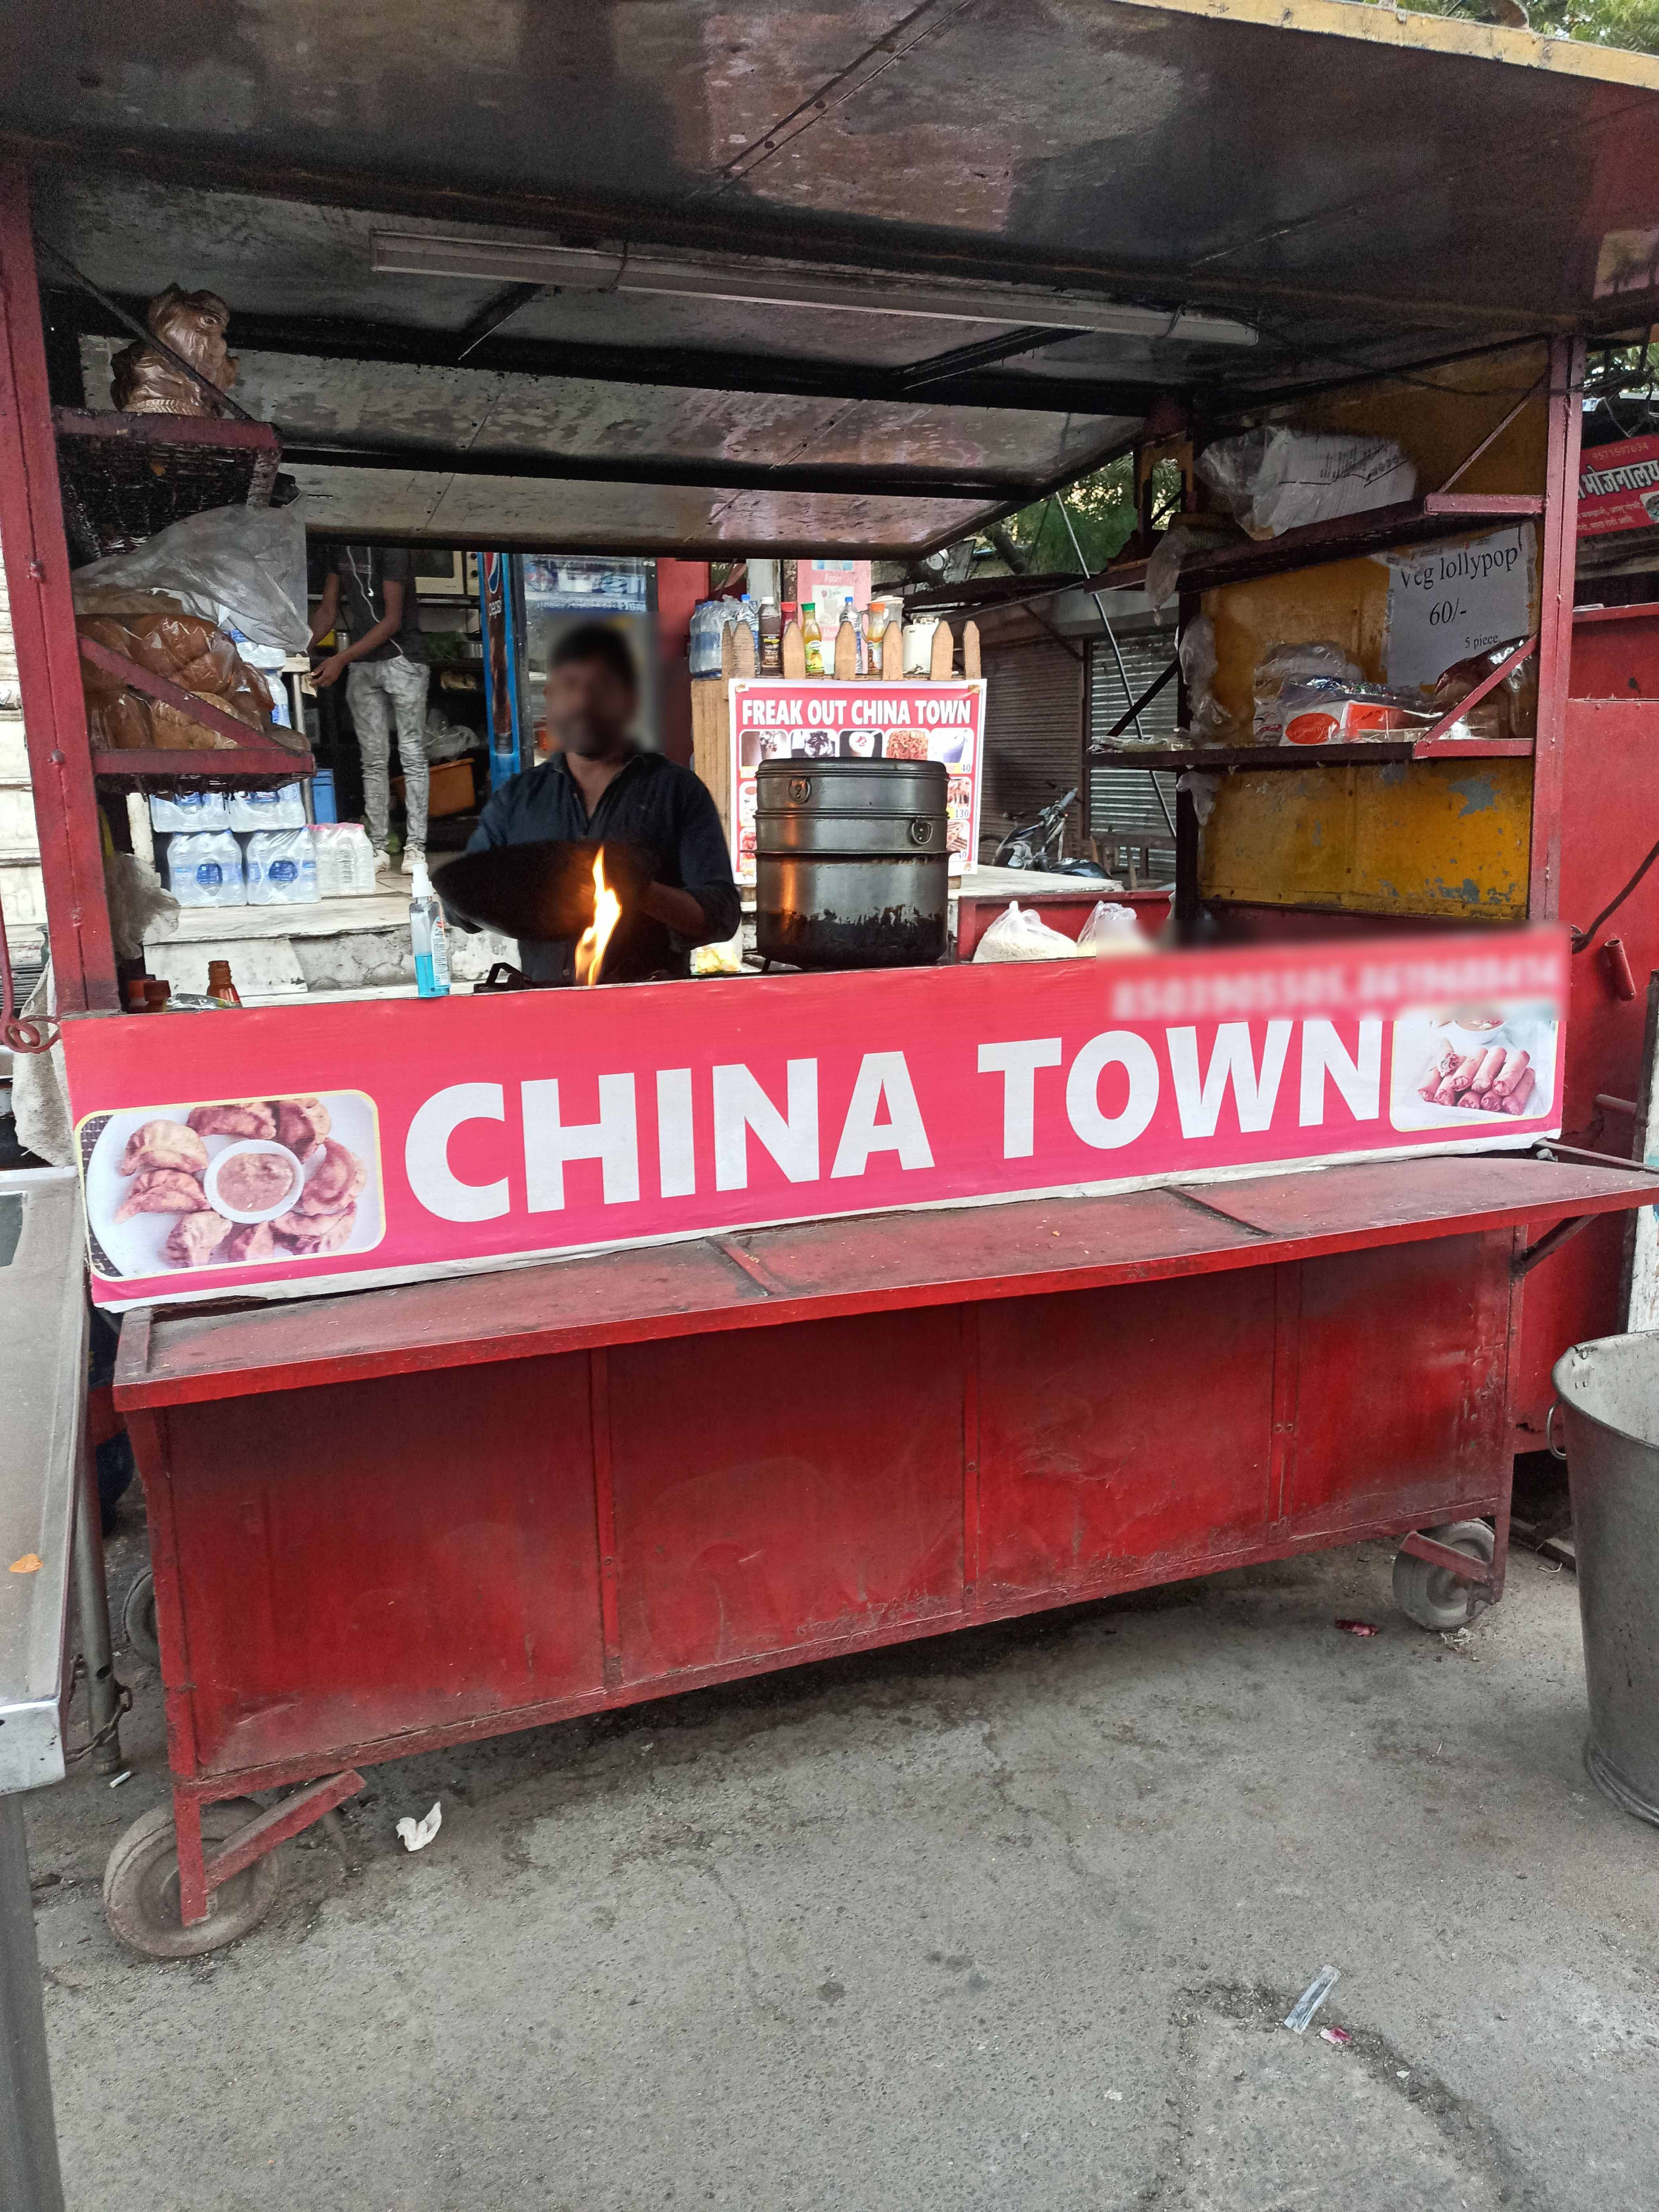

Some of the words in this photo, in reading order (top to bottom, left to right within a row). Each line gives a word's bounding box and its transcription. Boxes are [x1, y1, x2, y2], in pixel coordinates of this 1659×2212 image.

[1401, 567, 1434, 590] veg
[1439, 547, 1518, 581] lollypop
[1429, 598, 1467, 626] 60/-
[1465, 637, 1470, 648] 5
[742, 699, 804, 725] FREAK
[807, 700, 847, 725] OUT
[851, 699, 911, 725] CHINA
[915, 699, 971, 725] TOWN
[404, 1051, 935, 1223] CHINA
[978, 1016, 1383, 1160] TOWN
